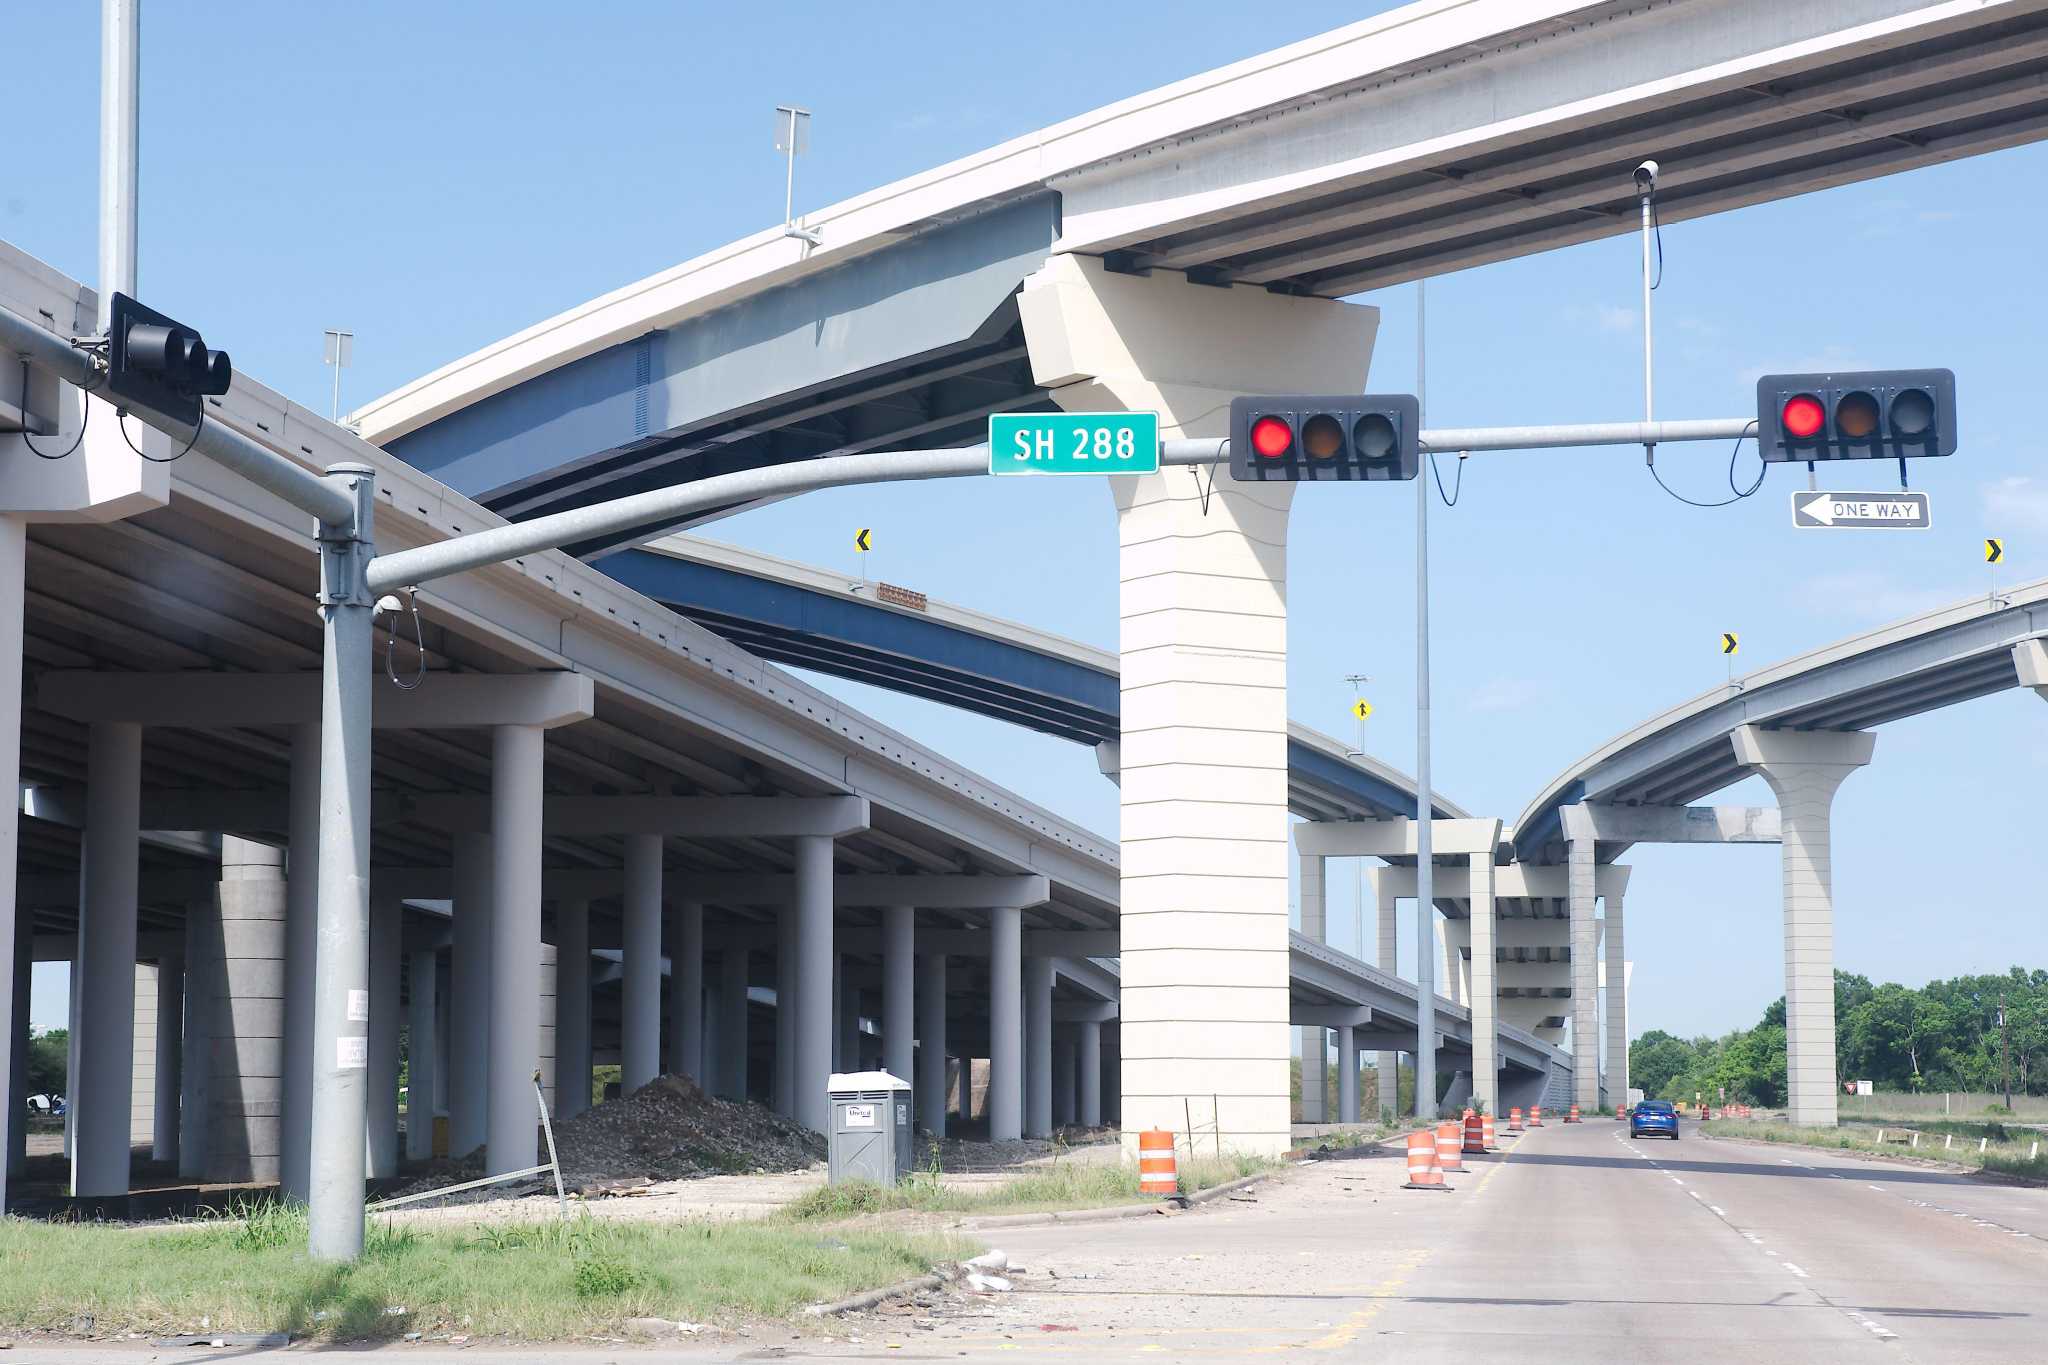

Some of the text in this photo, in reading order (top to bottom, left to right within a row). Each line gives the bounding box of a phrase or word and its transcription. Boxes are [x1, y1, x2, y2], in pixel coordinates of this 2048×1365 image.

[1014, 428, 1135, 460] SH 288
[1834, 503, 1913, 518] ONE WAY
